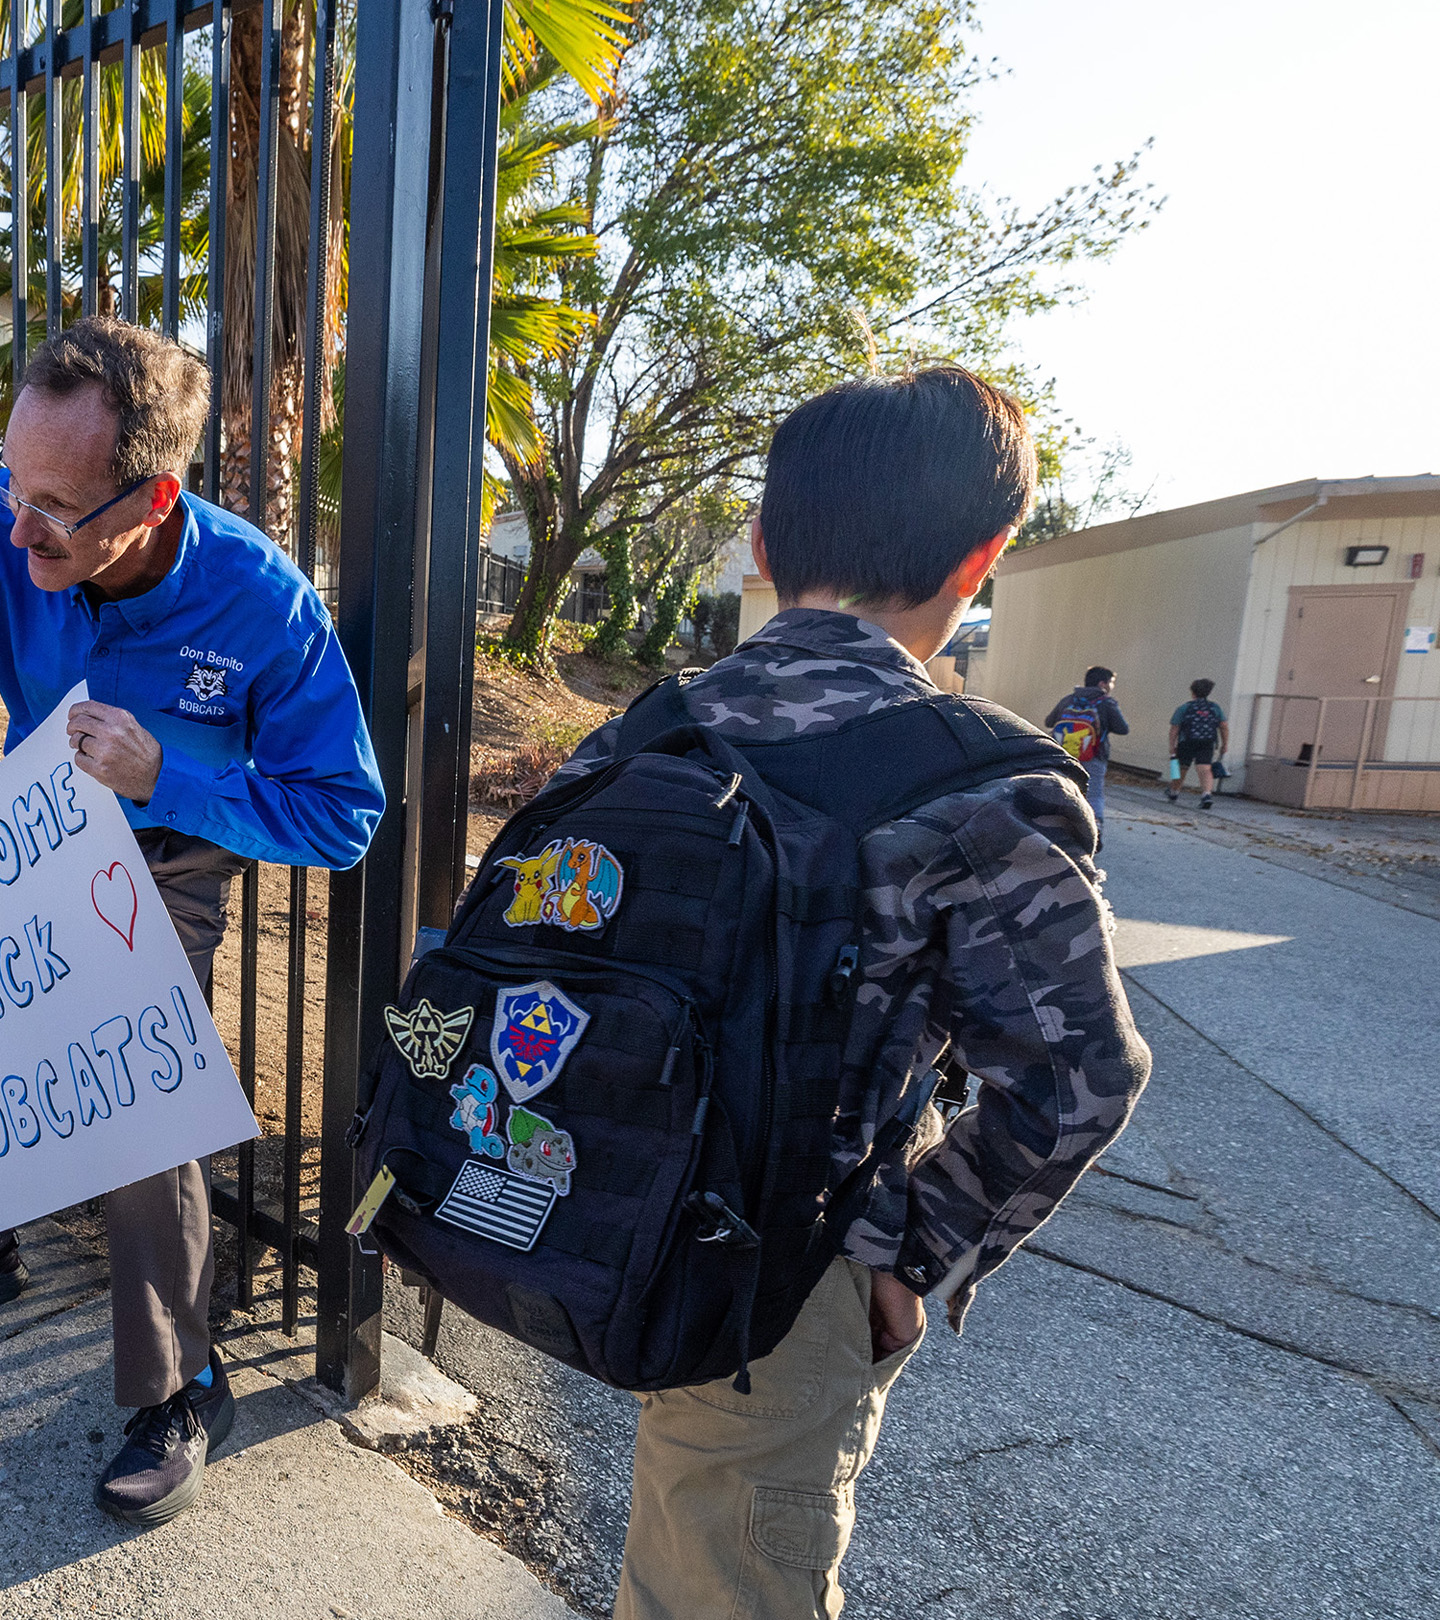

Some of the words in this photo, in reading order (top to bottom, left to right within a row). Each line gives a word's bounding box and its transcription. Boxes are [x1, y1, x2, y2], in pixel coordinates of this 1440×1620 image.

[180, 645, 204, 660] Don
[206, 650, 244, 672] Benito
[179, 698, 225, 716] BOBCATS
